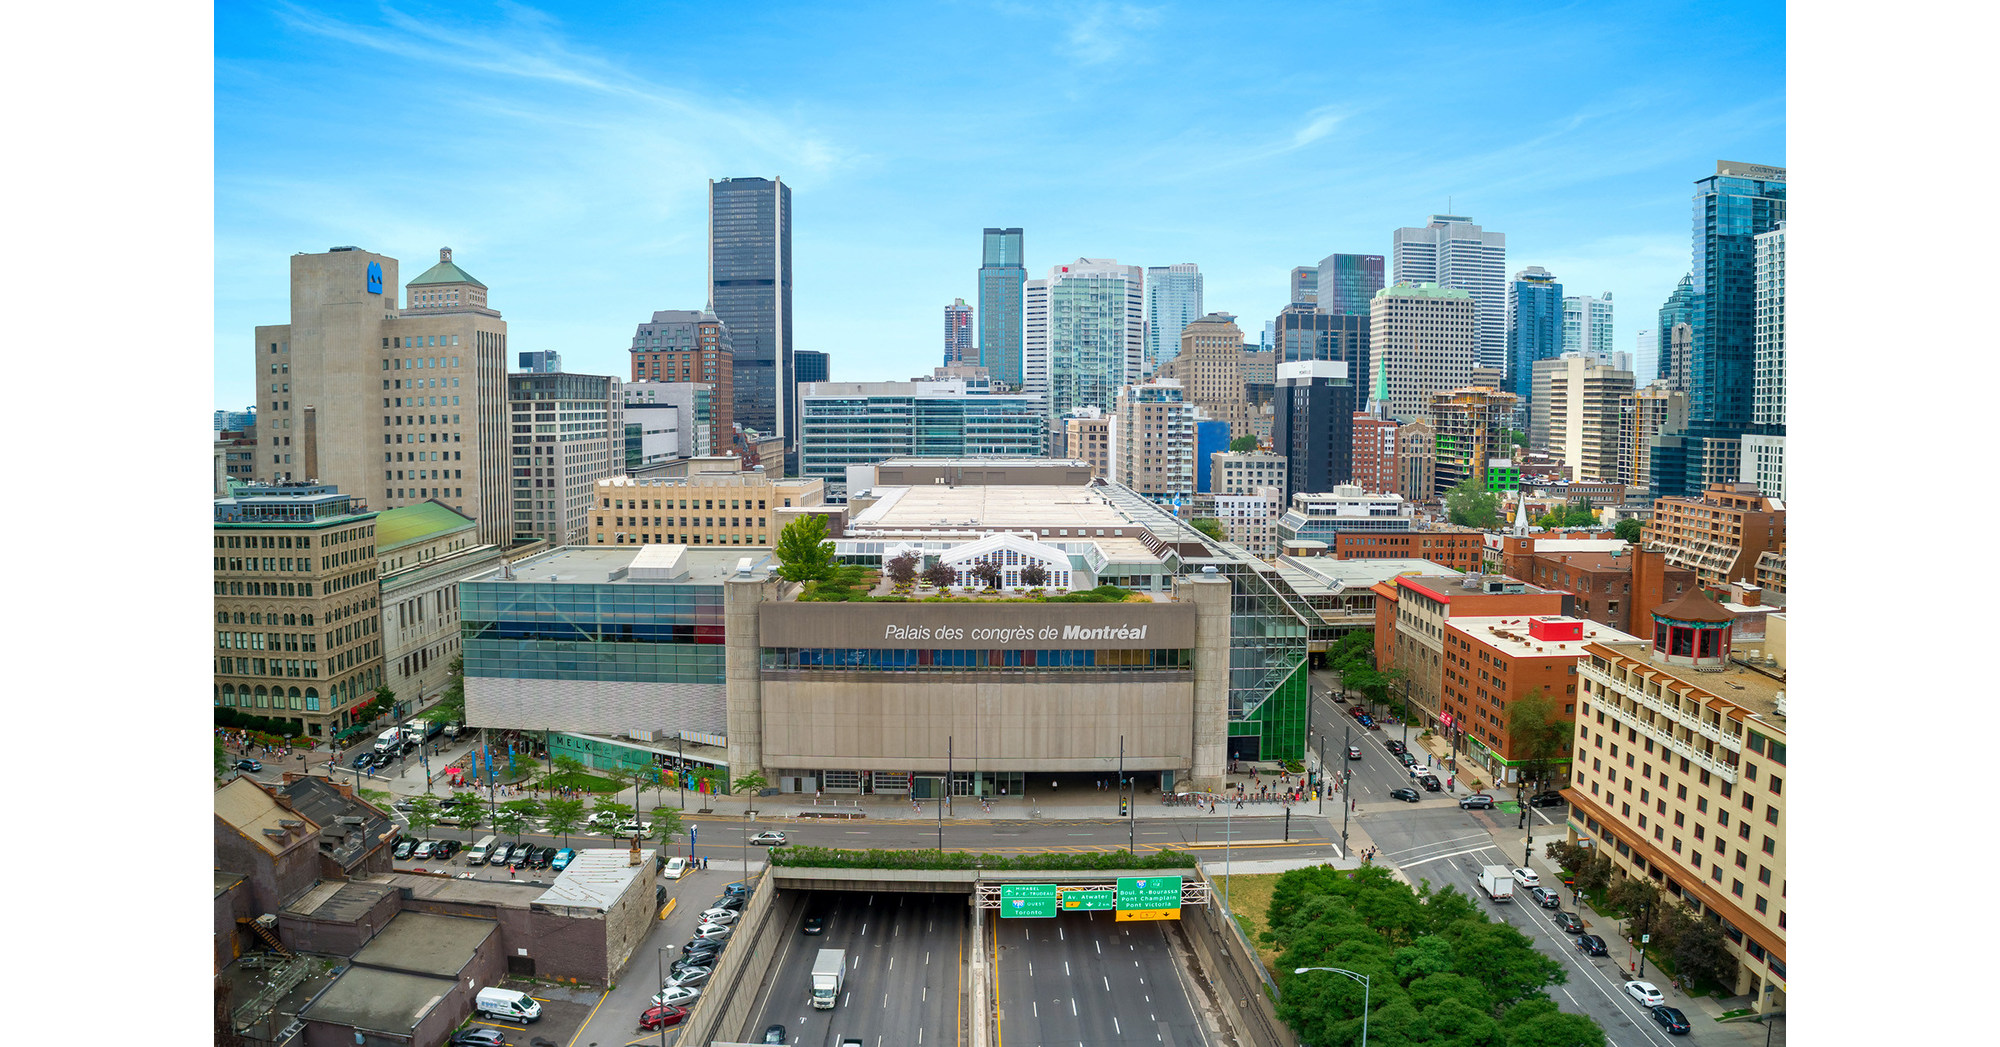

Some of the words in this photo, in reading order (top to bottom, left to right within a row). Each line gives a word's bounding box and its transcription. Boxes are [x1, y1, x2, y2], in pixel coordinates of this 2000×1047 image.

[884, 624, 930, 640] Palais
[935, 625, 964, 640] des
[972, 625, 1034, 643] congrès
[1038, 625, 1058, 640] de
[1062, 624, 1148, 640] Montréal
[556, 736, 591, 751] MELK
